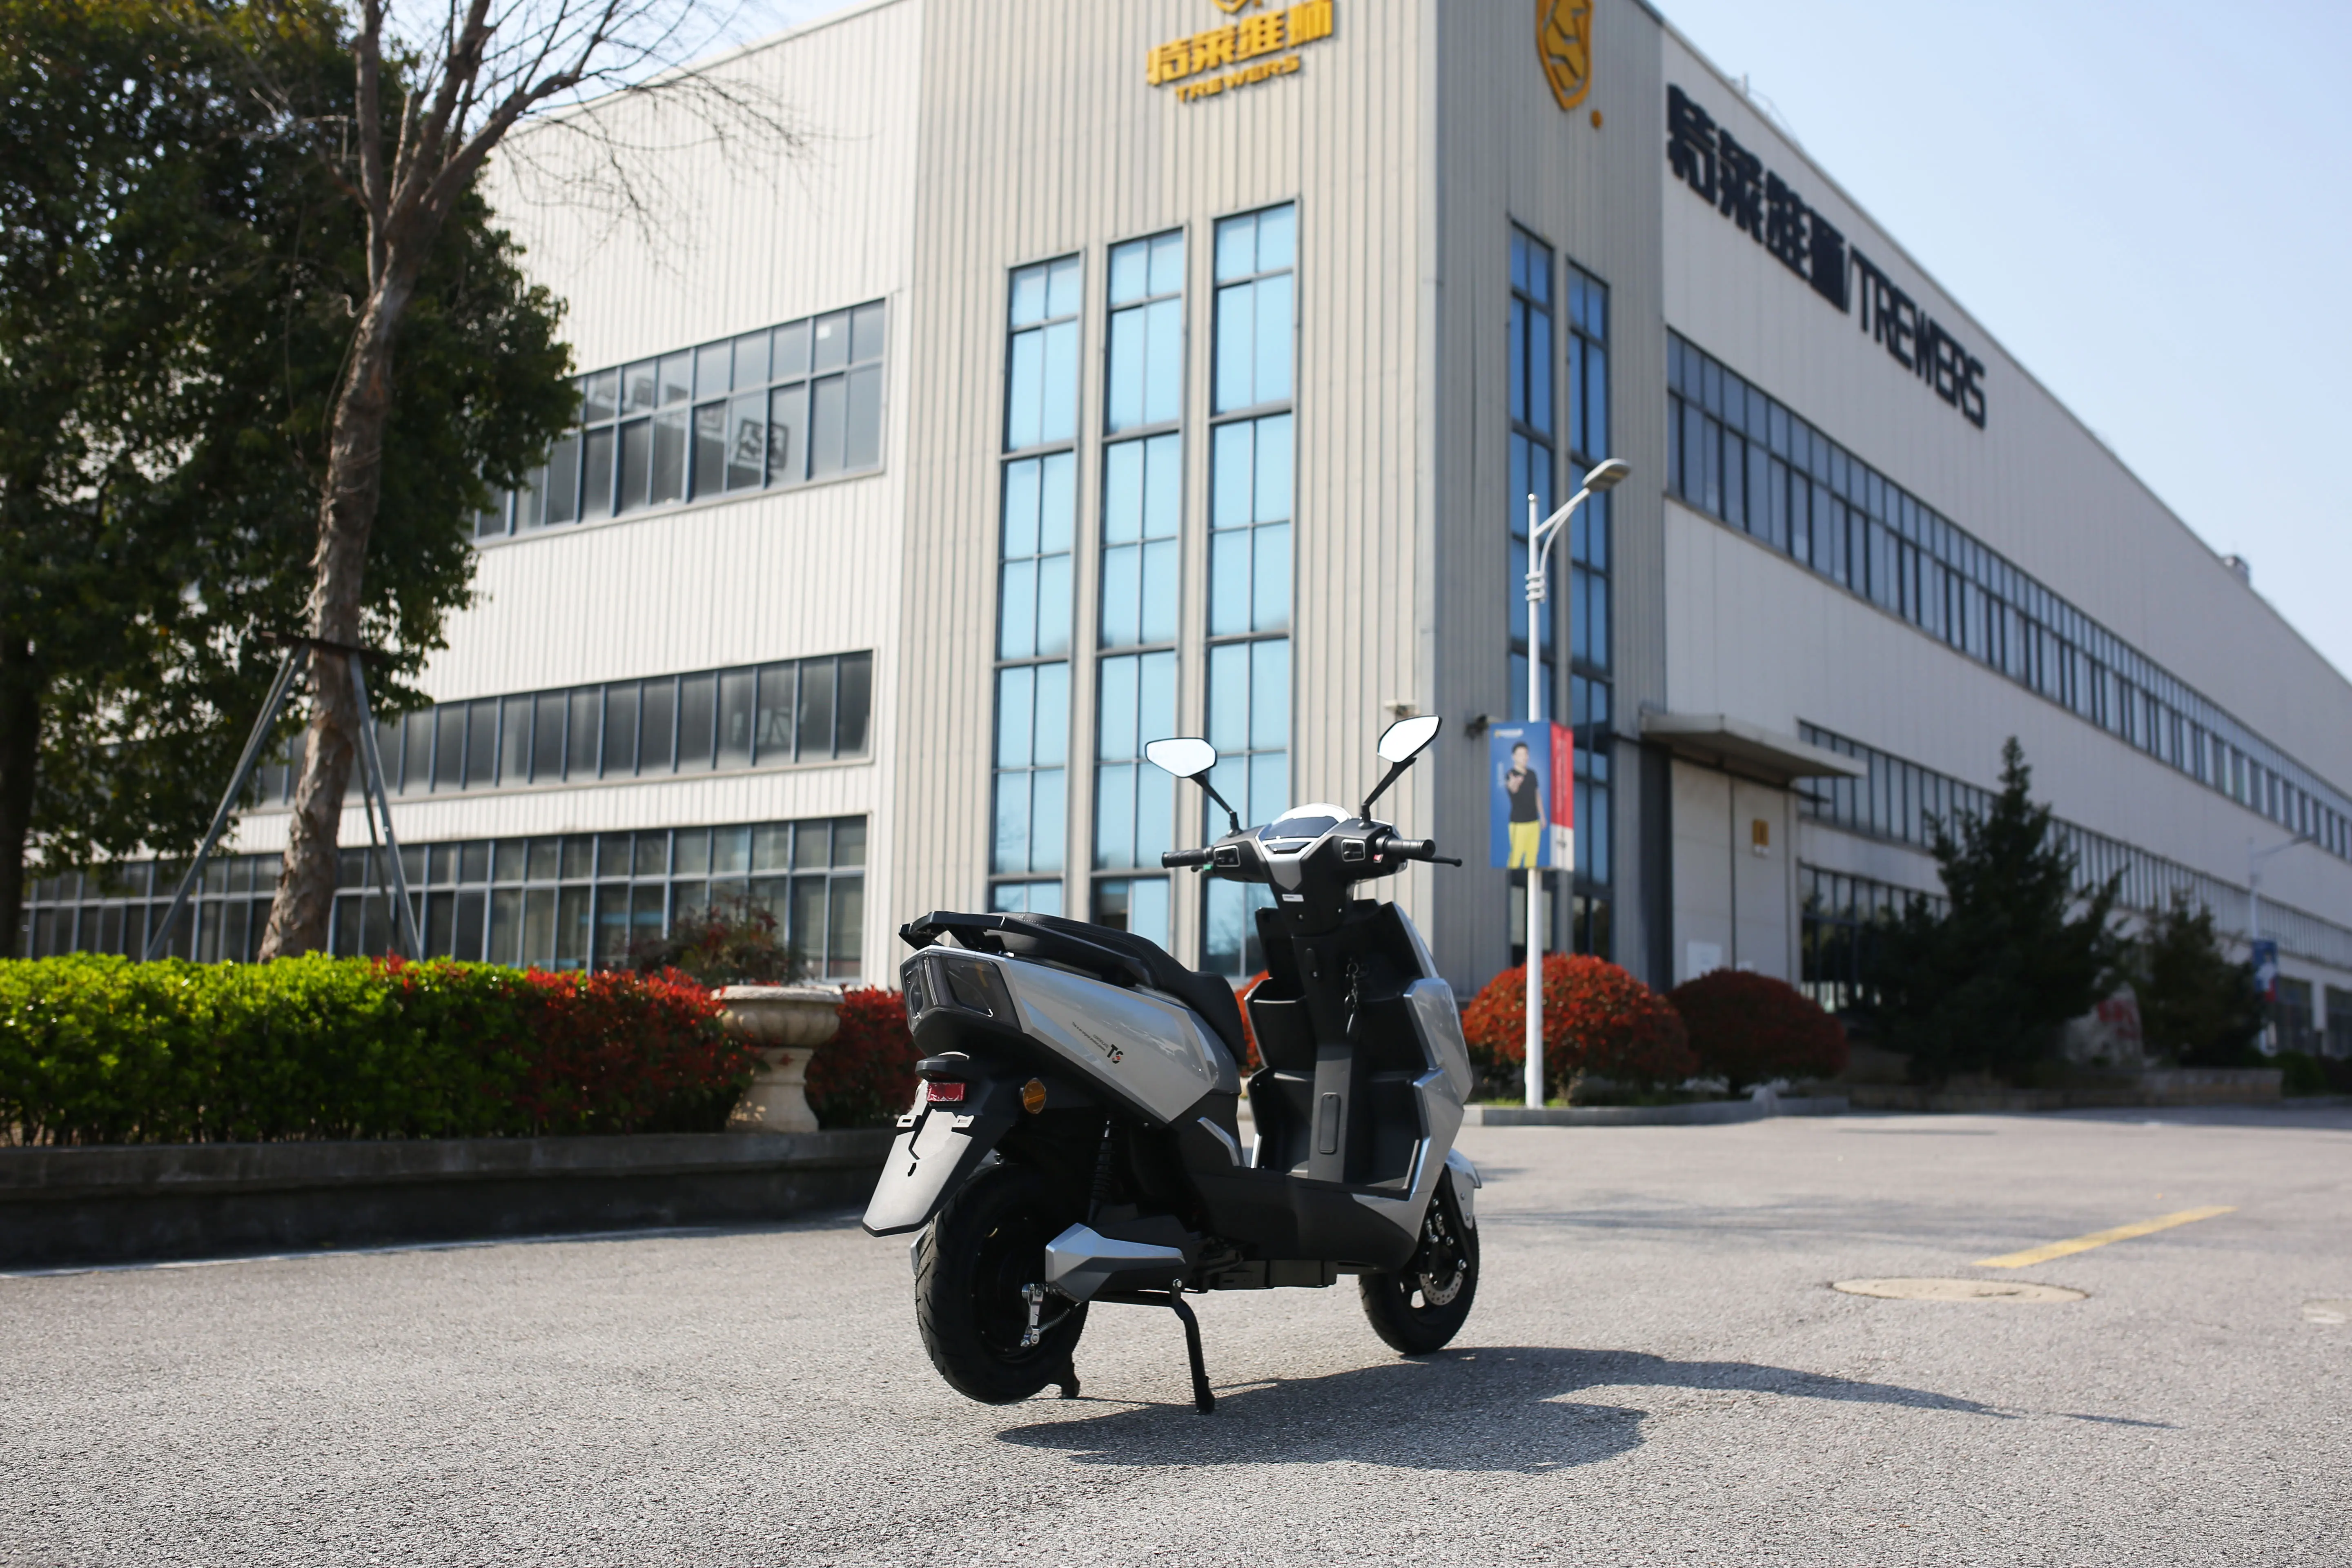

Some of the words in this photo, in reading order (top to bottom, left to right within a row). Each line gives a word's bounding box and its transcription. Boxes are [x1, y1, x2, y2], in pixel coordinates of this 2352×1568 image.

[1175, 55, 1300, 102] TREWERS
[1850, 244, 1986, 430] TREWERS
[1106, 1044, 1124, 1064] TS
